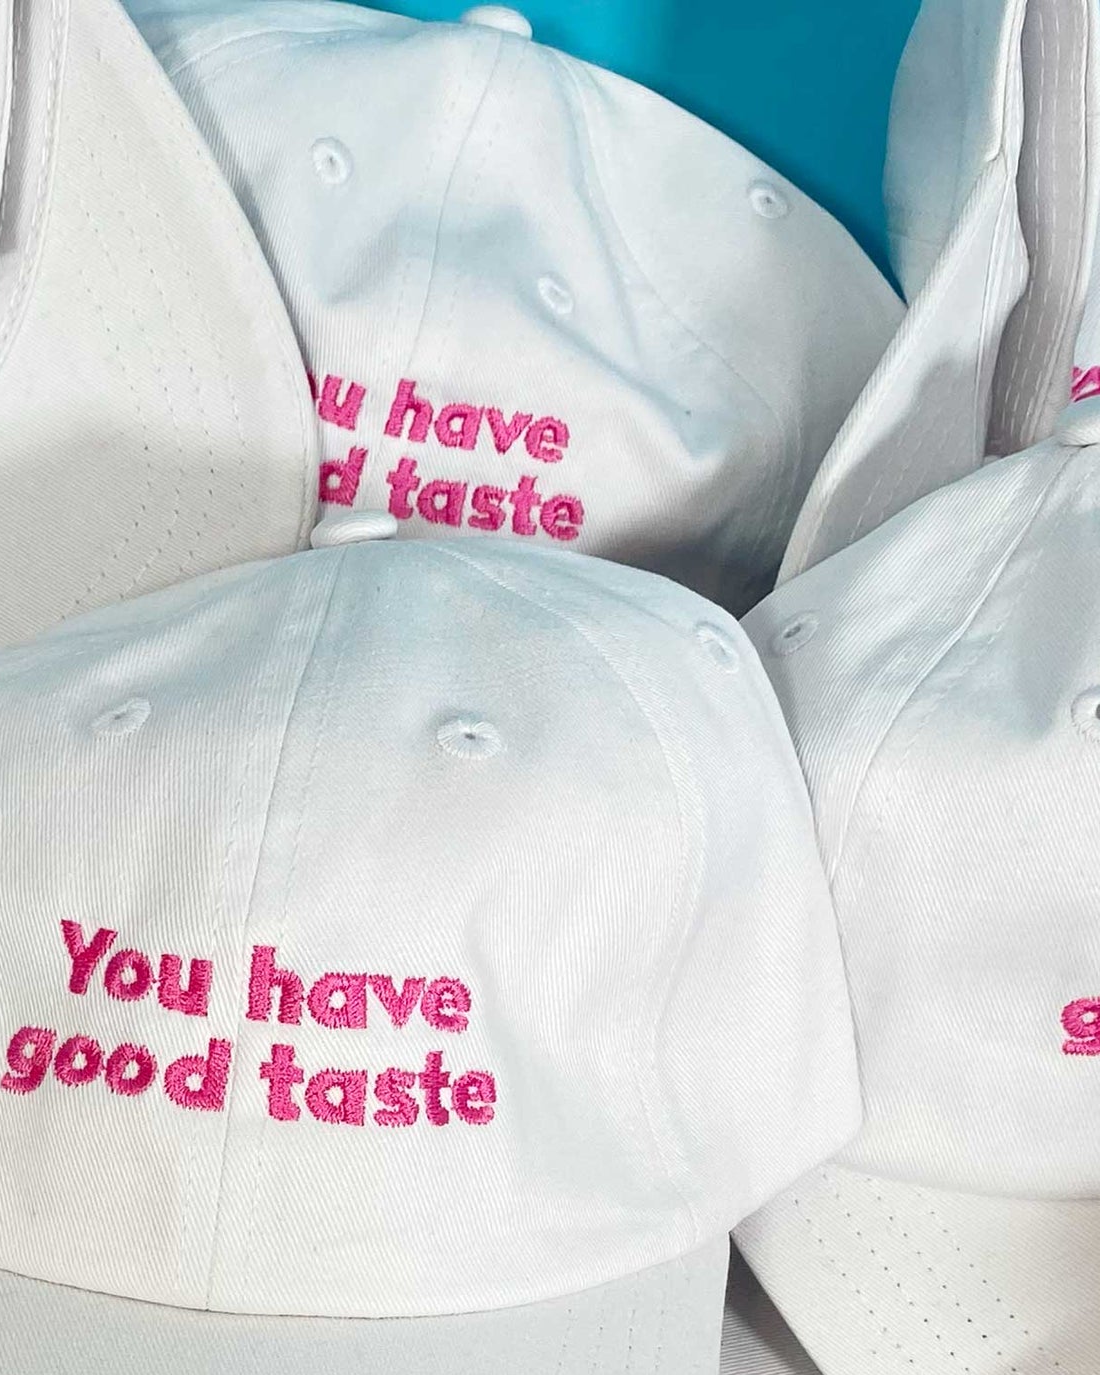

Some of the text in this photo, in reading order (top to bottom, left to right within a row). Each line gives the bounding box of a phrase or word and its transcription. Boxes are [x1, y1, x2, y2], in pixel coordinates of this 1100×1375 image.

[384, 379, 570, 463] have
[387, 458, 584, 541] taste
[61, 920, 472, 1033] You have
[1, 1026, 497, 1128] good taste
